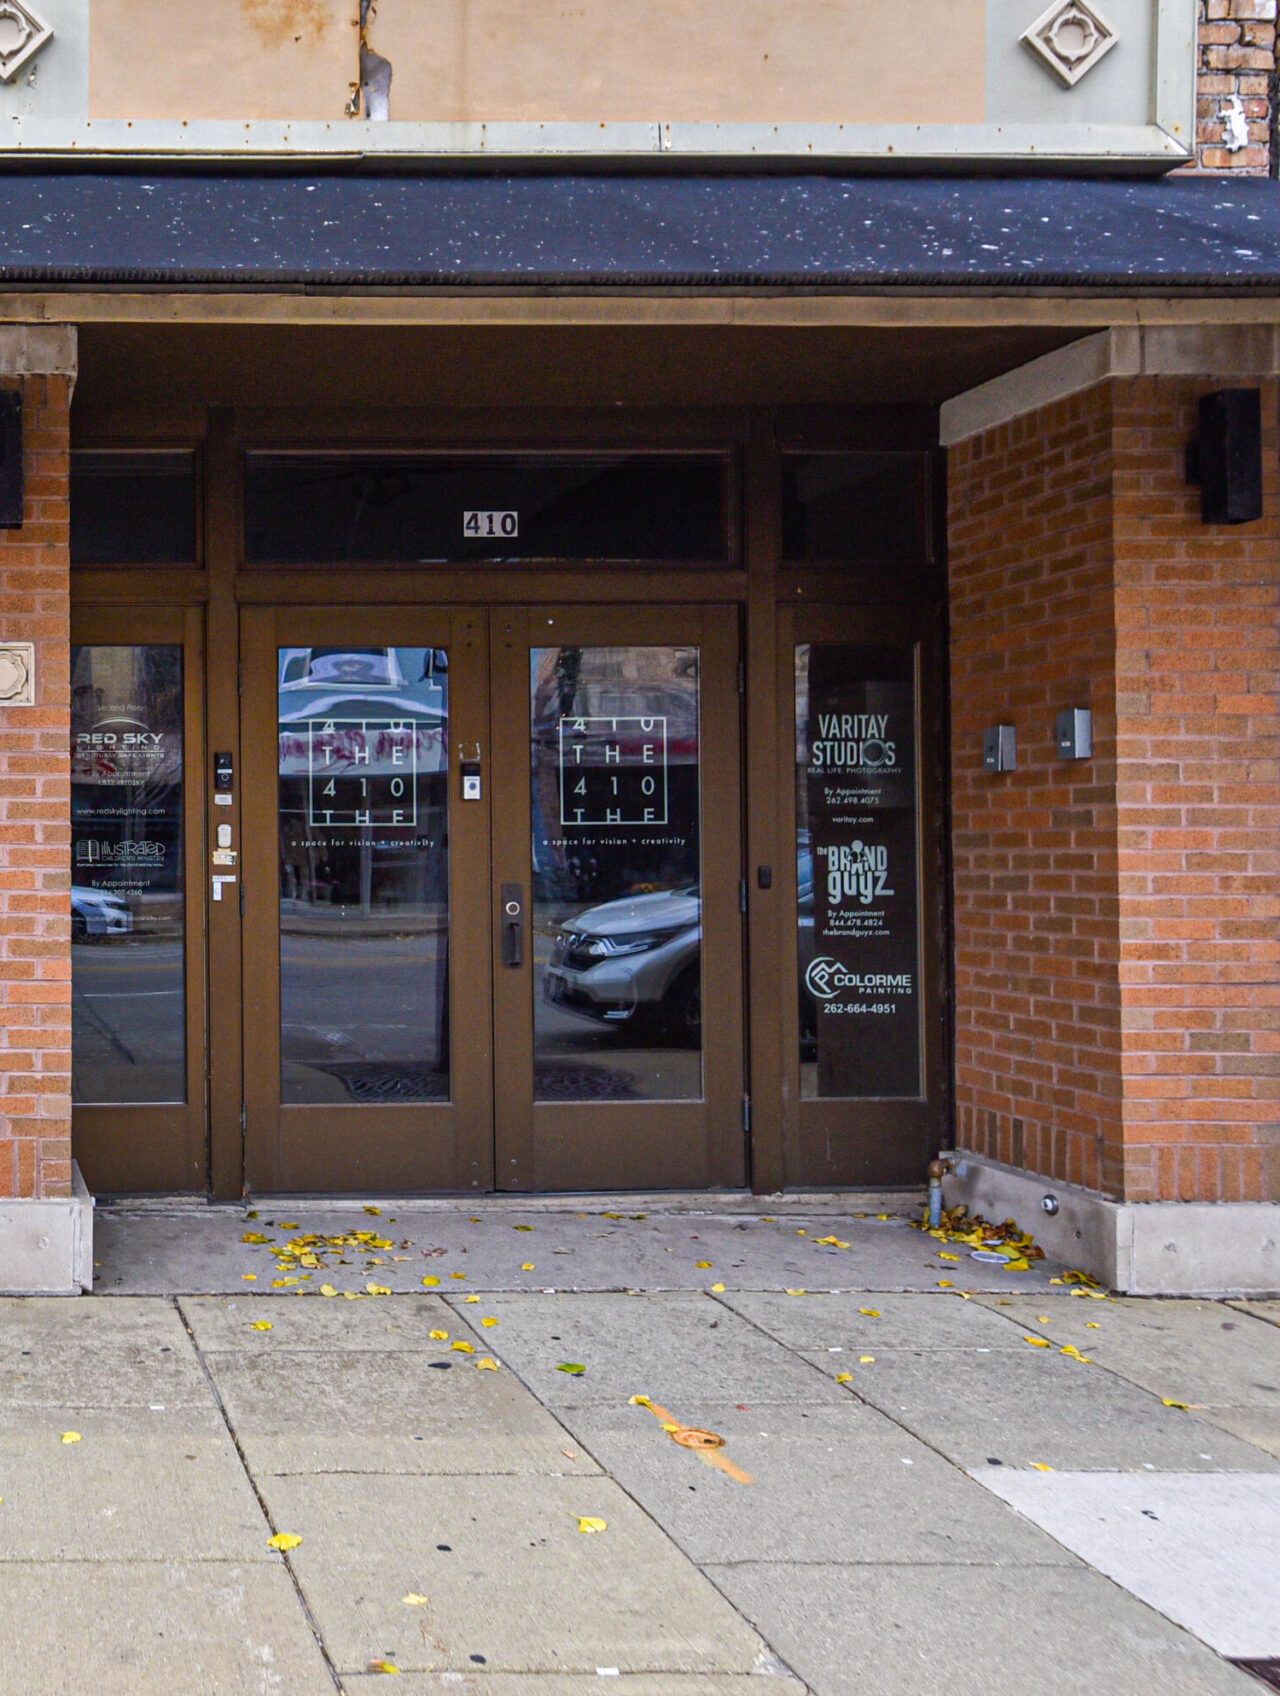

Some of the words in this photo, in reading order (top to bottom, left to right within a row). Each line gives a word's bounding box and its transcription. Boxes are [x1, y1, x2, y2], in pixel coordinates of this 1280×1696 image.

[466, 513, 516, 535] 410
[818, 714, 889, 739] VARITAY
[77, 733, 117, 744] RED
[123, 733, 164, 744] SKY
[812, 739, 896, 766] STUDIOS
[824, 787, 833, 796] By
[836, 787, 882, 796] Appointment
[832, 815, 874, 825] varitay.com
[301, 840, 327, 848] space
[331, 838, 345, 847] for
[349, 838, 376, 847] vision
[390, 838, 435, 848] creativity
[552, 839, 578, 847] space
[582, 837, 596, 846] for
[600, 837, 627, 845] vision
[641, 837, 686, 846] creativity
[91, 880, 100, 888] By
[102, 880, 150, 888] Appointment
[827, 871, 895, 904] guyz
[828, 910, 836, 918] By
[839, 910, 885, 919] Appointment
[823, 929, 890, 938] thebrandguyz.com
[834, 974, 911, 987] COLORME
[824, 1004, 896, 1014] 262-664-4951
